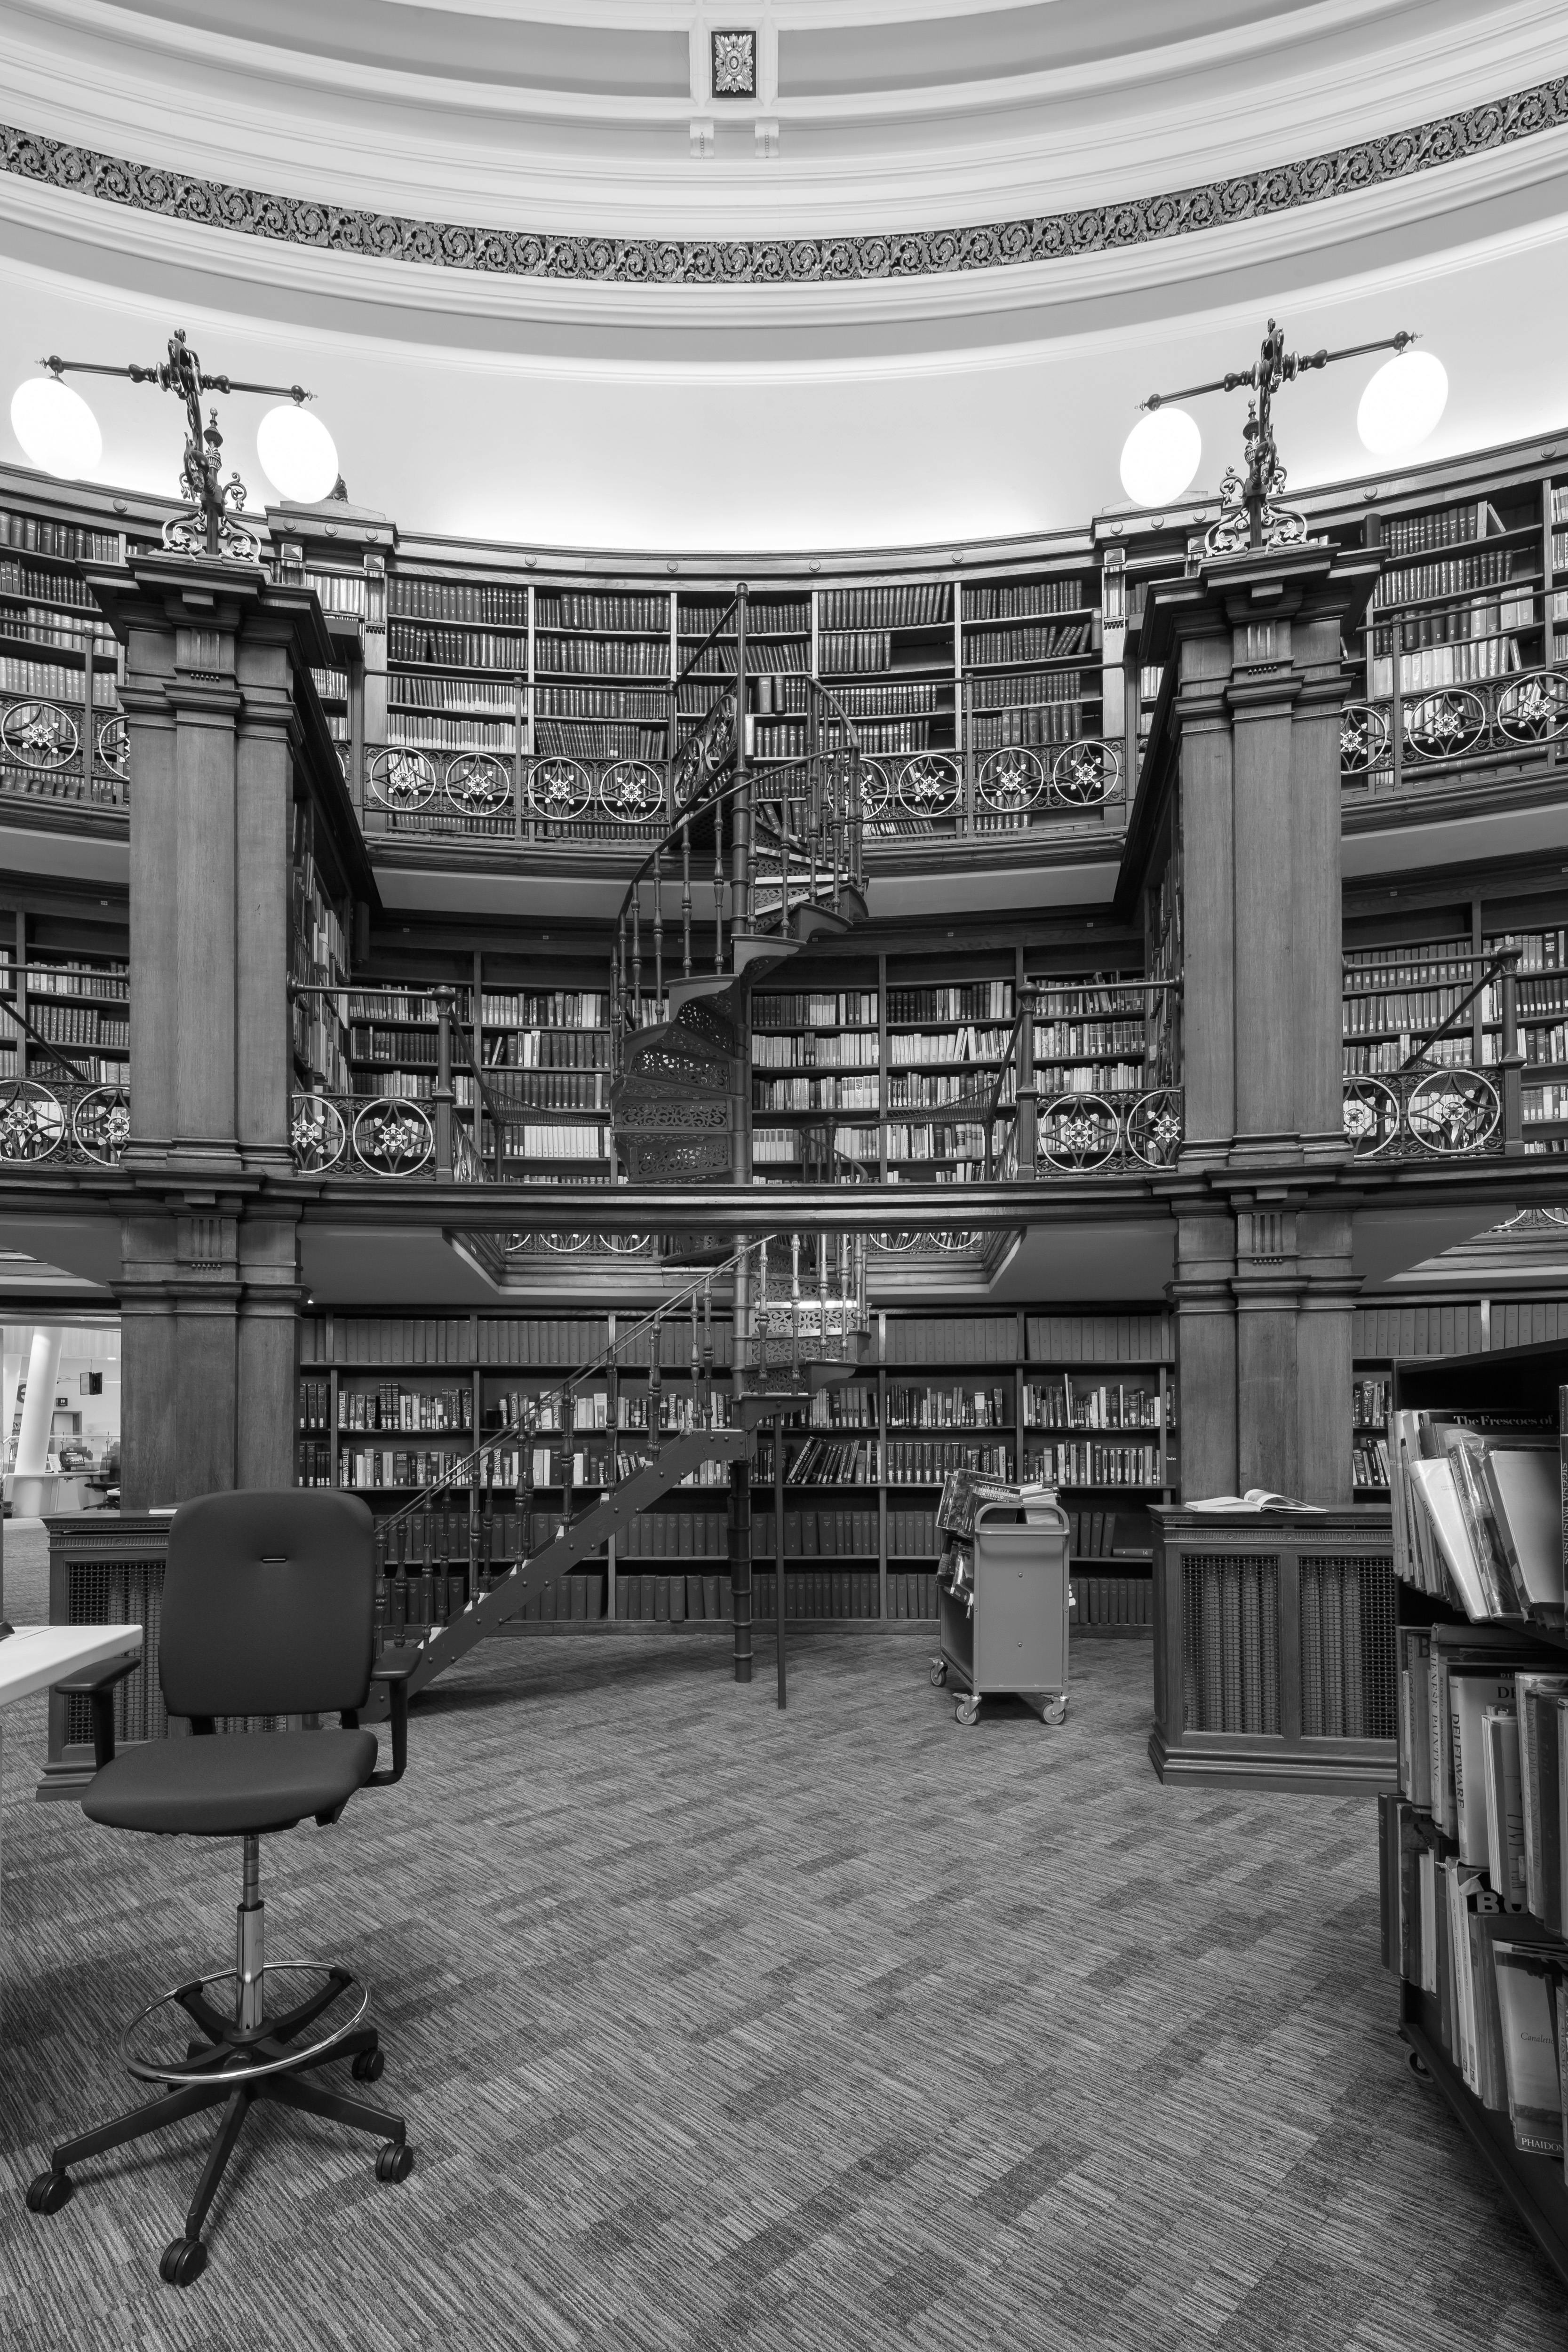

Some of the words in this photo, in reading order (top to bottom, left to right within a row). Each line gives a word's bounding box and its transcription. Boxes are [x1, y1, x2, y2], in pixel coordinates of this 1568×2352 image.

[1454, 1416, 1479, 1425] The
[1480, 1416, 1537, 1426] Frescoes
[1540, 1415, 1553, 1424] of
[1422, 1501, 1436, 1528] CIMABUE
[1452, 1713, 1465, 1809] DELFTWARE
[1520, 2032, 1555, 2044] Canaletto
[1521, 2137, 1564, 2153] PHAIDON
